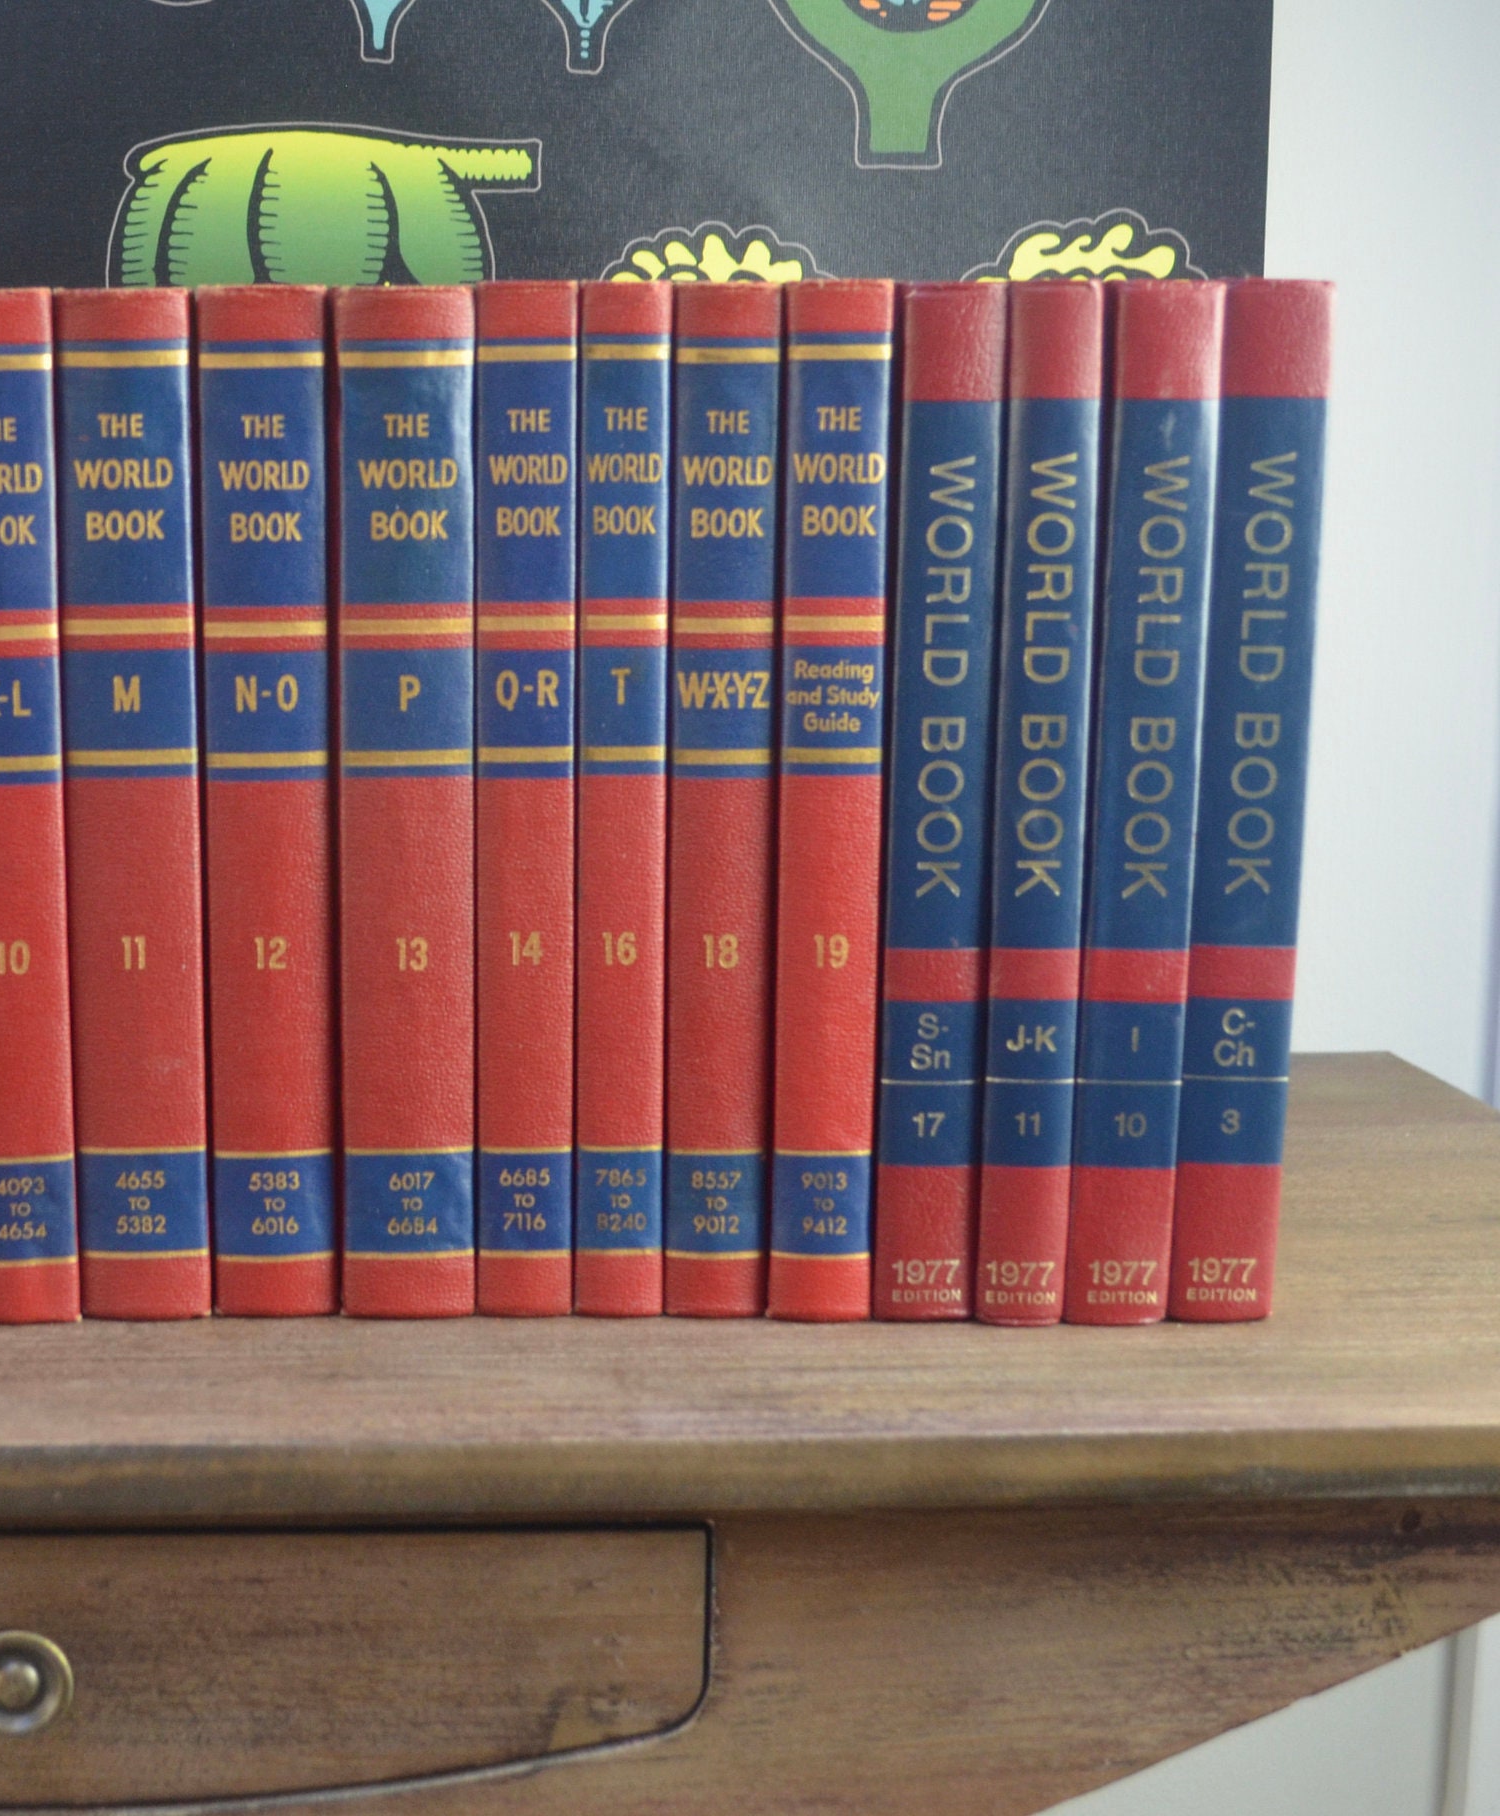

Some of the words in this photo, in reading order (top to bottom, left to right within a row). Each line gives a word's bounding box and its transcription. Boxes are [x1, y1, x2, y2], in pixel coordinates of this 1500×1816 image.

[98, 414, 143, 438] THE
[241, 415, 284, 438] THE
[384, 414, 429, 438] THE
[507, 408, 550, 433] THE
[605, 407, 648, 432] THE
[707, 410, 750, 435] THE
[817, 407, 862, 432] THE
[75, 458, 173, 490] WORLD
[219, 459, 309, 490] WORLD
[358, 458, 458, 489] WORLD
[490, 455, 567, 485] WORLD
[588, 453, 663, 483] WORLD
[682, 456, 773, 487] WORLD
[794, 453, 885, 484] WORLD
[86, 510, 165, 542] BOOK
[231, 511, 302, 543] BOOK
[371, 510, 448, 541] BOOK
[496, 506, 561, 537] BOOK
[593, 506, 656, 536] BOOK
[691, 508, 764, 539] BOOK
[802, 506, 876, 536] BOOK
[923, 455, 976, 686] WORLD
[1024, 452, 1078, 683] WORLD
[1134, 456, 1190, 686] WORLD
[1239, 452, 1297, 682] WORLD
[794, 661, 874, 683] Reading
[113, 676, 140, 713] M
[236, 674, 298, 712] N-O
[400, 674, 421, 712] P
[496, 670, 559, 709] Q-R
[611, 669, 631, 705] T
[678, 671, 770, 710] W-X-Y-Z
[787, 687, 822, 705] and
[826, 686, 880, 709] Study
[803, 713, 860, 733] Guide
[916, 717, 966, 898] BOOK
[1015, 714, 1067, 897] BOOK
[1122, 717, 1176, 899] BOOK
[1225, 713, 1281, 894] BOOK
[122, 936, 146, 971] 11
[254, 937, 287, 971] 12
[396, 938, 429, 972] 13
[509, 932, 543, 965] 14
[602, 932, 637, 965] 16
[703, 934, 739, 969] 18
[813, 934, 850, 968] 19
[1006, 1027, 1057, 1052] J-K
[1132, 1027, 1138, 1052] I
[911, 1045, 950, 1070] Sn
[1214, 1041, 1254, 1066] Ch
[912, 1113, 945, 1137] 17
[1015, 1112, 1041, 1135] 11
[1115, 1112, 1146, 1137] 10
[1221, 1110, 1240, 1134] 3
[115, 1171, 166, 1190] 4655
[248, 1171, 300, 1191] 5383
[389, 1171, 434, 1191] 6017
[499, 1168, 550, 1187] 6685
[691, 1170, 741, 1189] 8557
[802, 1171, 848, 1190] 9013
[10, 1203, 31, 1217] TO
[129, 1197, 150, 1211] TO
[264, 1198, 285, 1210] TO
[402, 1198, 423, 1211] TO
[514, 1194, 535, 1207] TO
[116, 1216, 166, 1234] 5382
[251, 1217, 299, 1236] 6016
[503, 1213, 546, 1232] 7116
[693, 1216, 739, 1235] 9012
[802, 1216, 847, 1235] 9412
[892, 1259, 961, 1284] 1977
[986, 1260, 1055, 1286] 1977
[1088, 1260, 1157, 1286] 1977
[1188, 1258, 1257, 1283] 1977
[892, 1289, 962, 1302] EDITION
[986, 1290, 1055, 1304] EDITION
[1088, 1290, 1157, 1304] EDITION
[1187, 1288, 1257, 1301] EDITION
